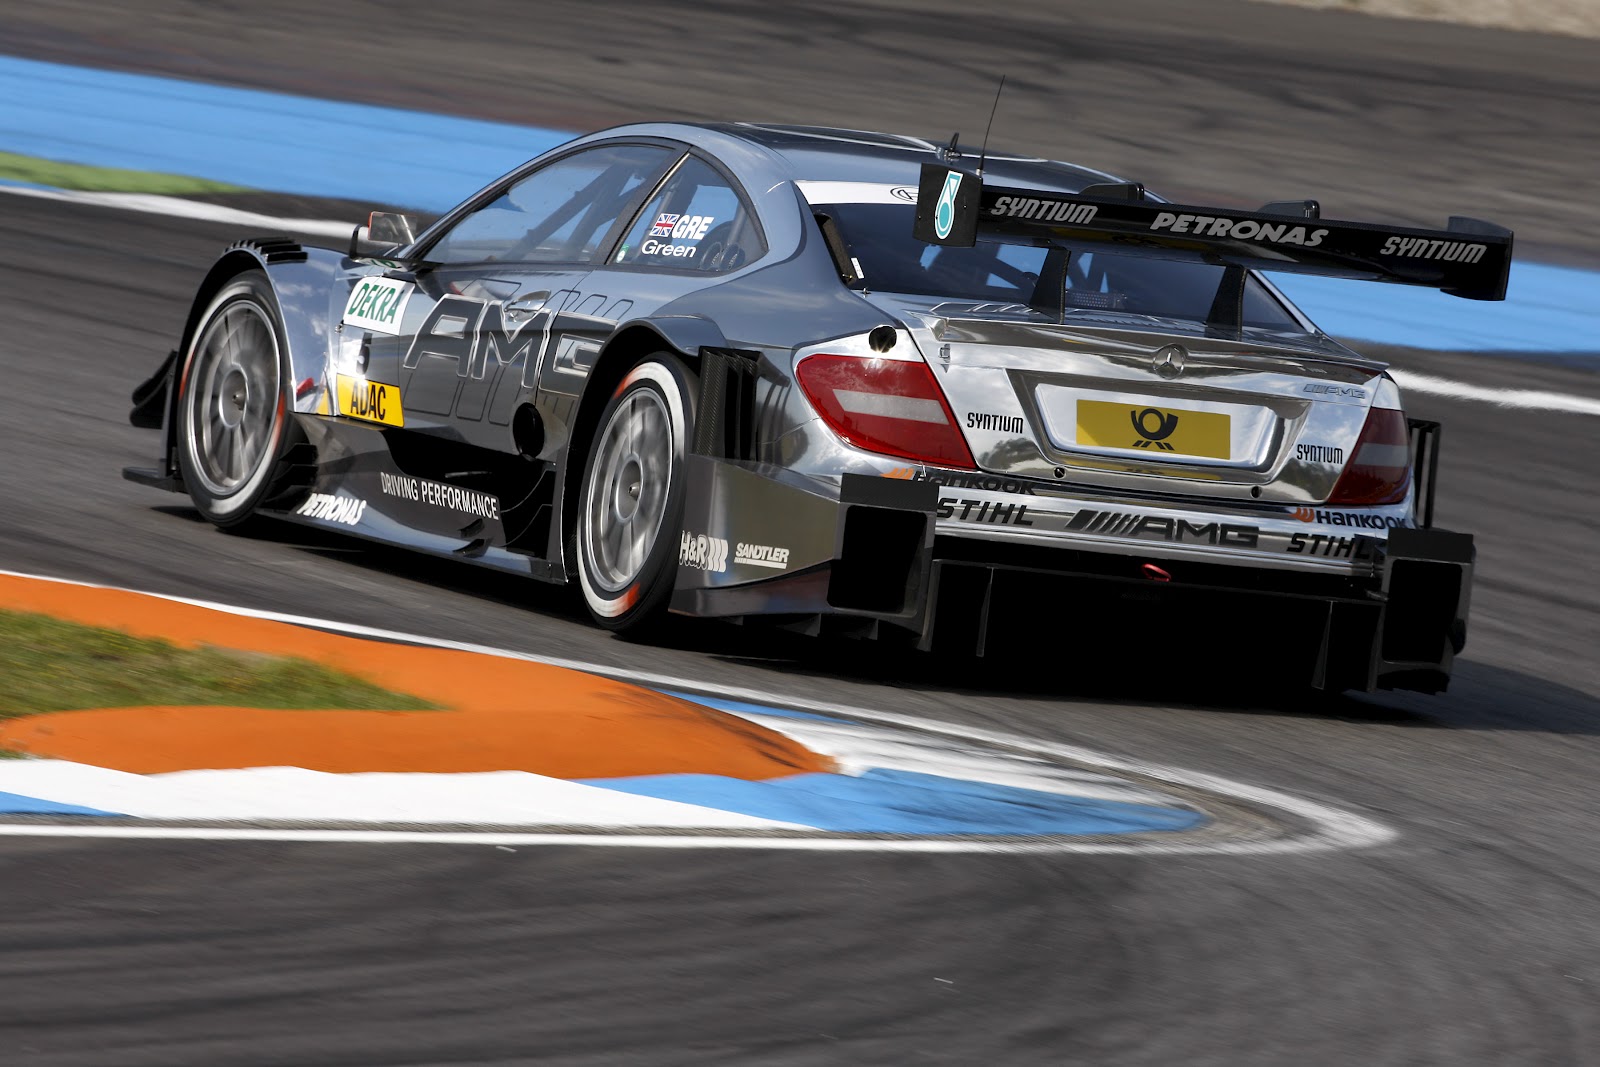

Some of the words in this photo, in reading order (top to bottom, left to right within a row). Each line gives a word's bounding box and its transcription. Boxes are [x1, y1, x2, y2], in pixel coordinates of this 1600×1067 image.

[991, 196, 1098, 225] SYNTIUM
[671, 214, 714, 240] GRE
[1150, 212, 1329, 247] PETRONAS
[641, 239, 697, 258] Green
[1380, 236, 1487, 264] SYNTIUM
[348, 282, 405, 325] DEKRA
[403, 293, 620, 398] AMG
[350, 380, 386, 421] ADAC
[966, 412, 1024, 434] SYNTIUM
[1297, 443, 1343, 464] SYNTIUM
[296, 492, 367, 526] PETRONAS
[380, 471, 419, 501] DRIVING
[421, 481, 499, 520] PERFORMANCE
[936, 497, 1033, 526] STIHL
[735, 542, 790, 562] SANDTLER
[1286, 532, 1371, 560] STIHL
